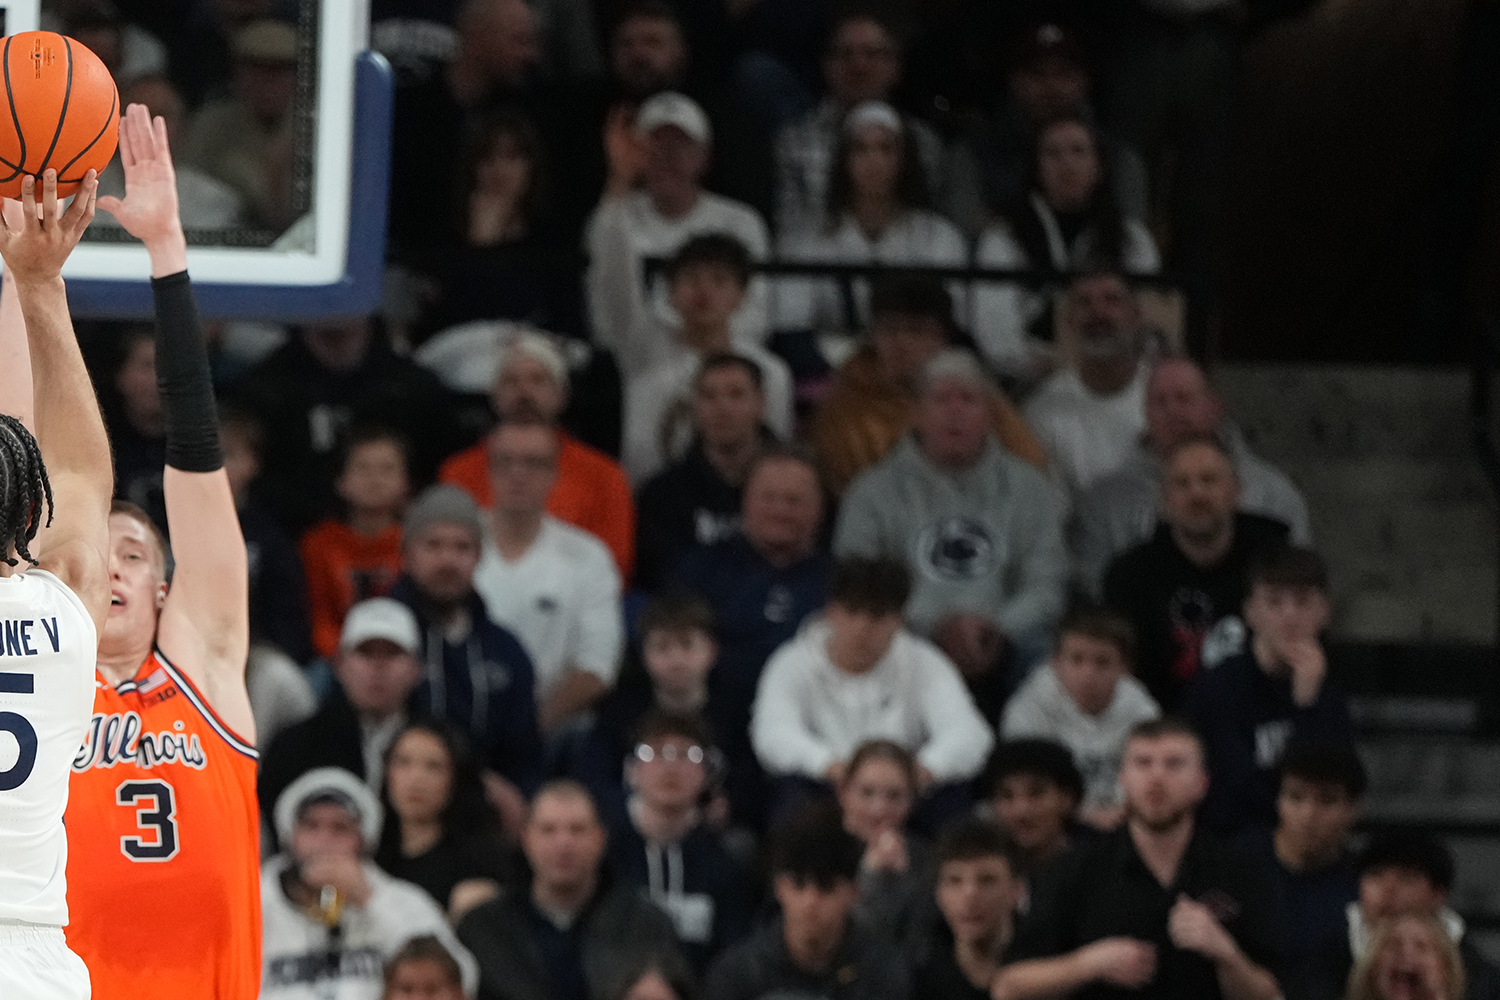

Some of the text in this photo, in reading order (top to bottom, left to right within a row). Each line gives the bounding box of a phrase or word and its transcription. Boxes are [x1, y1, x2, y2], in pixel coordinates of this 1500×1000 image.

[41, 617, 60, 653] V
[71, 711, 207, 774] Illnois
[116, 778, 181, 863] 3
